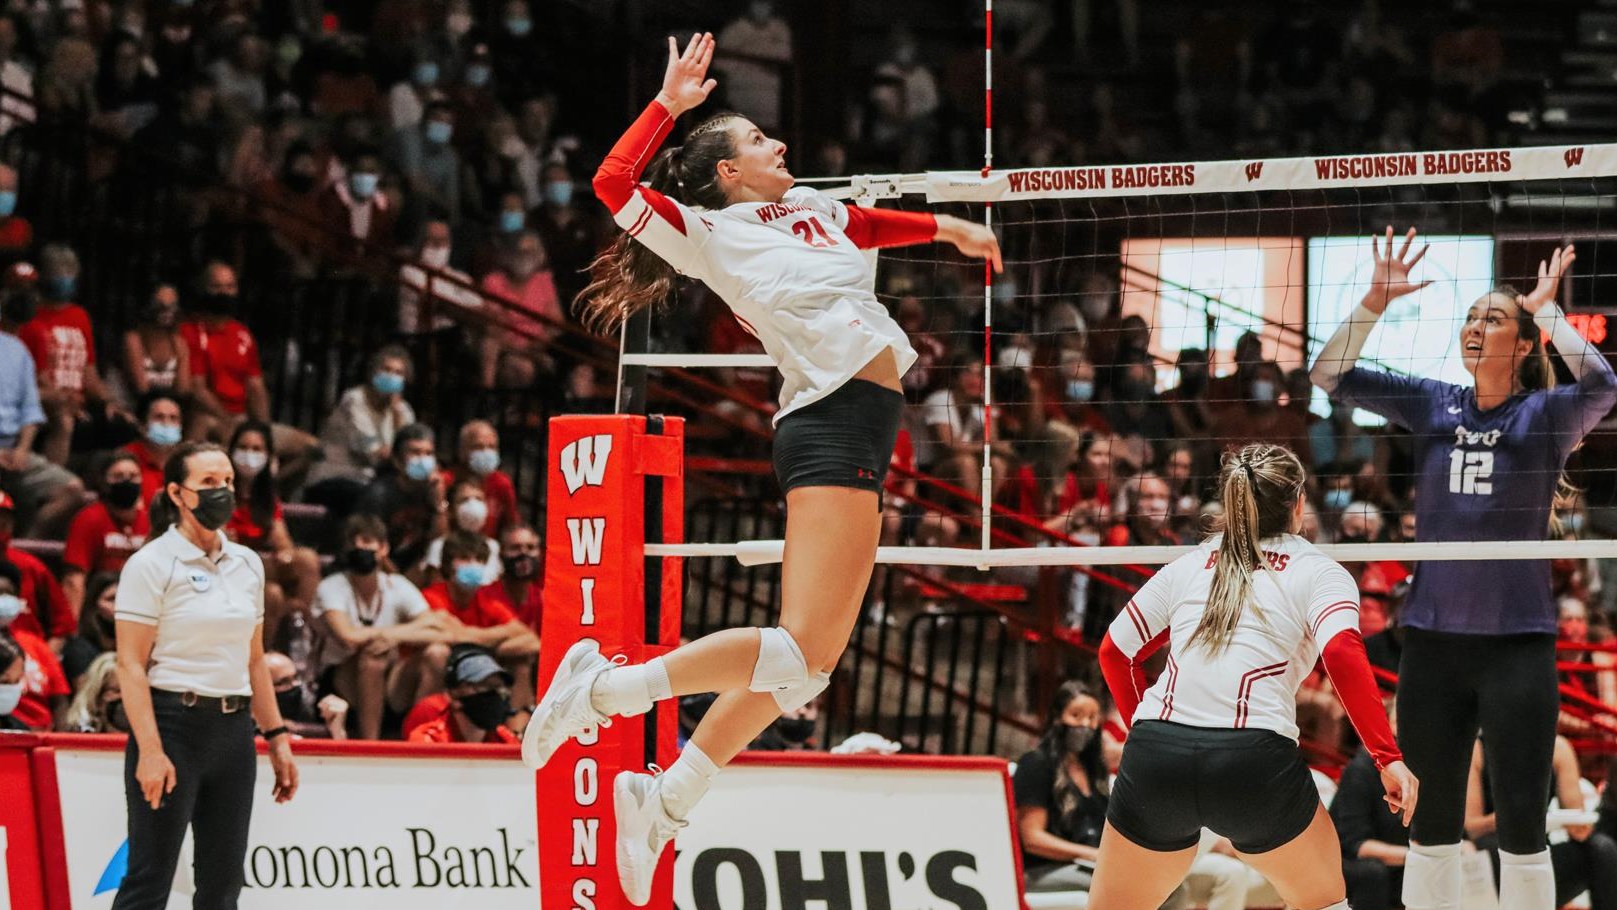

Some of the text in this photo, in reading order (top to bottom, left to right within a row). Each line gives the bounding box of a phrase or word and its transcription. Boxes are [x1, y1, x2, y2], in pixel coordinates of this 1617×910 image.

[1245, 161, 1264, 183] W
[1314, 150, 1512, 180] WISCONSIN BADGERS
[1564, 147, 1584, 169] W
[1008, 164, 1196, 192] WISCONSIN BADGERS
[791, 216, 840, 247] 21
[560, 434, 613, 495] W
[1449, 448, 1494, 495] 12
[566, 517, 606, 910] WIONS
[241, 828, 531, 888] onona Bank
[673, 847, 989, 910] OHL'S
